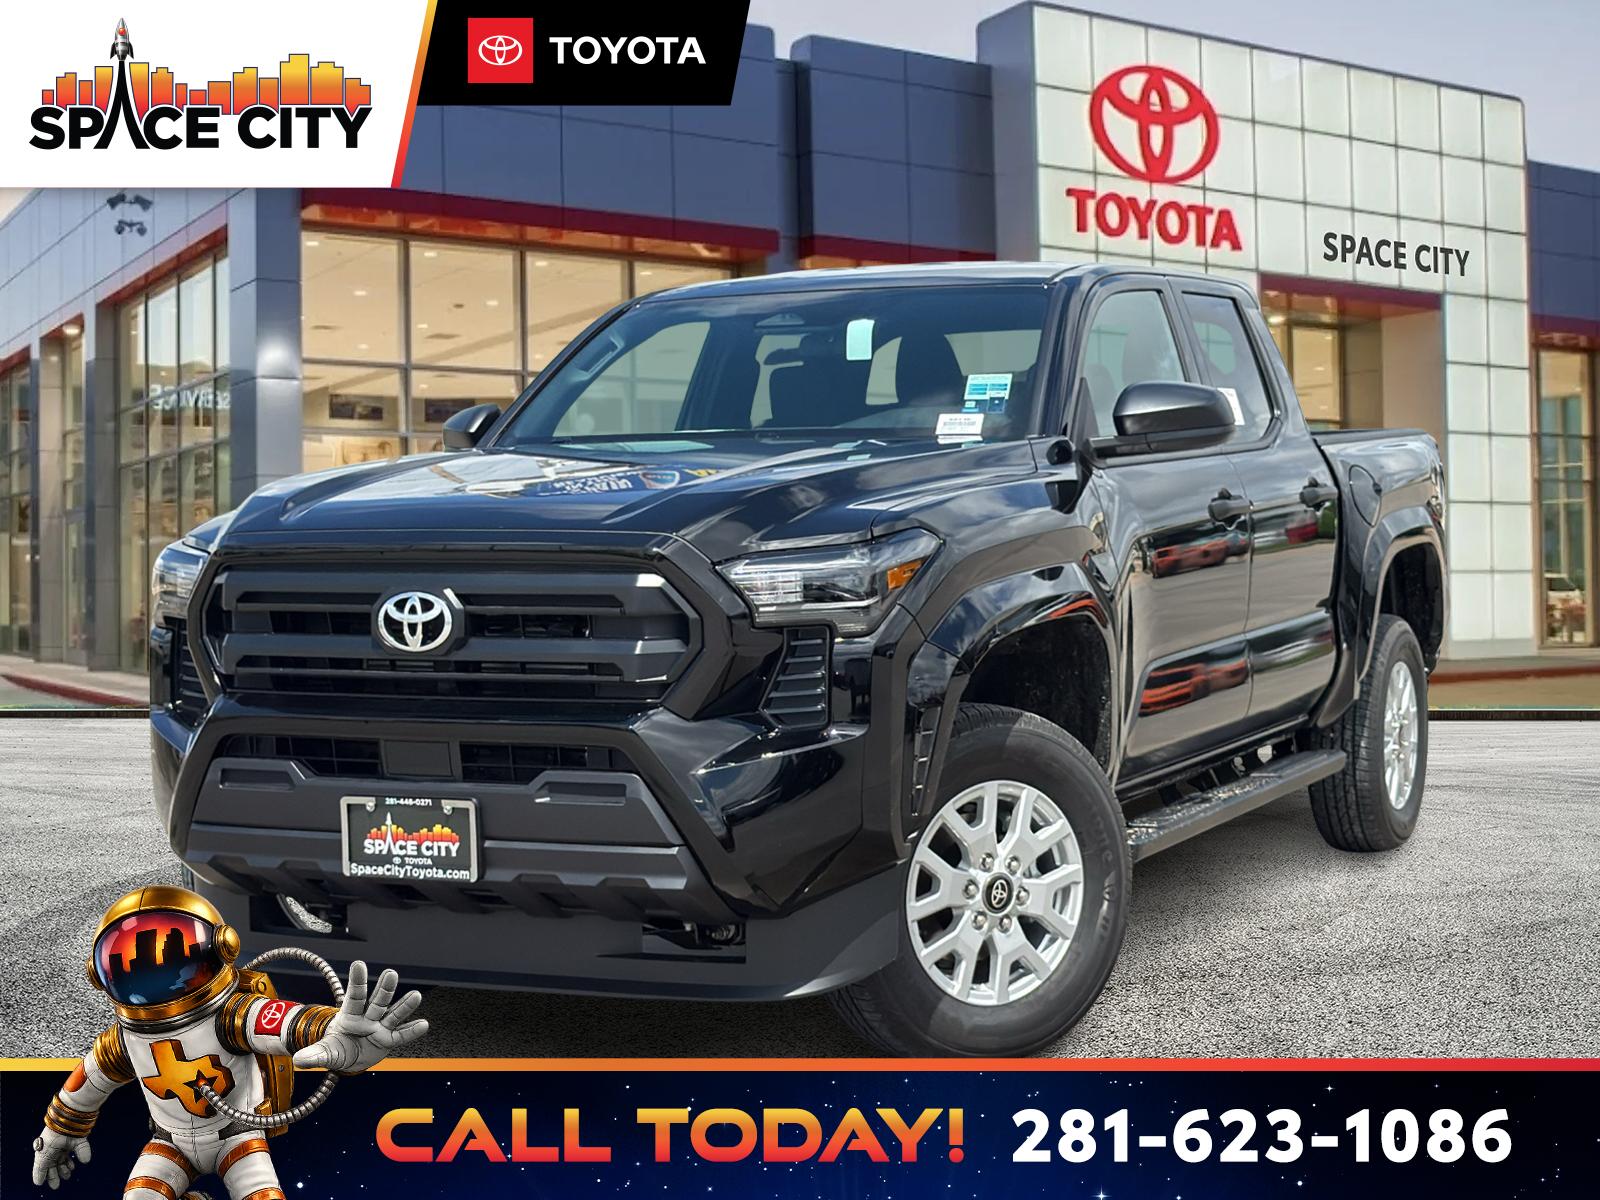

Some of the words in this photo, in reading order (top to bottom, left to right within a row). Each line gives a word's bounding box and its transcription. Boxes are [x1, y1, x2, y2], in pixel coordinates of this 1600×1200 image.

[1066, 187, 1243, 252] TOYOTA
[1323, 231, 1407, 270] SPACE
[1414, 243, 1470, 277] CITY
[421, 840, 460, 857] CITY
[404, 857, 432, 865] TOYOTA
[350, 863, 470, 879] SpaceCityToyota.com
